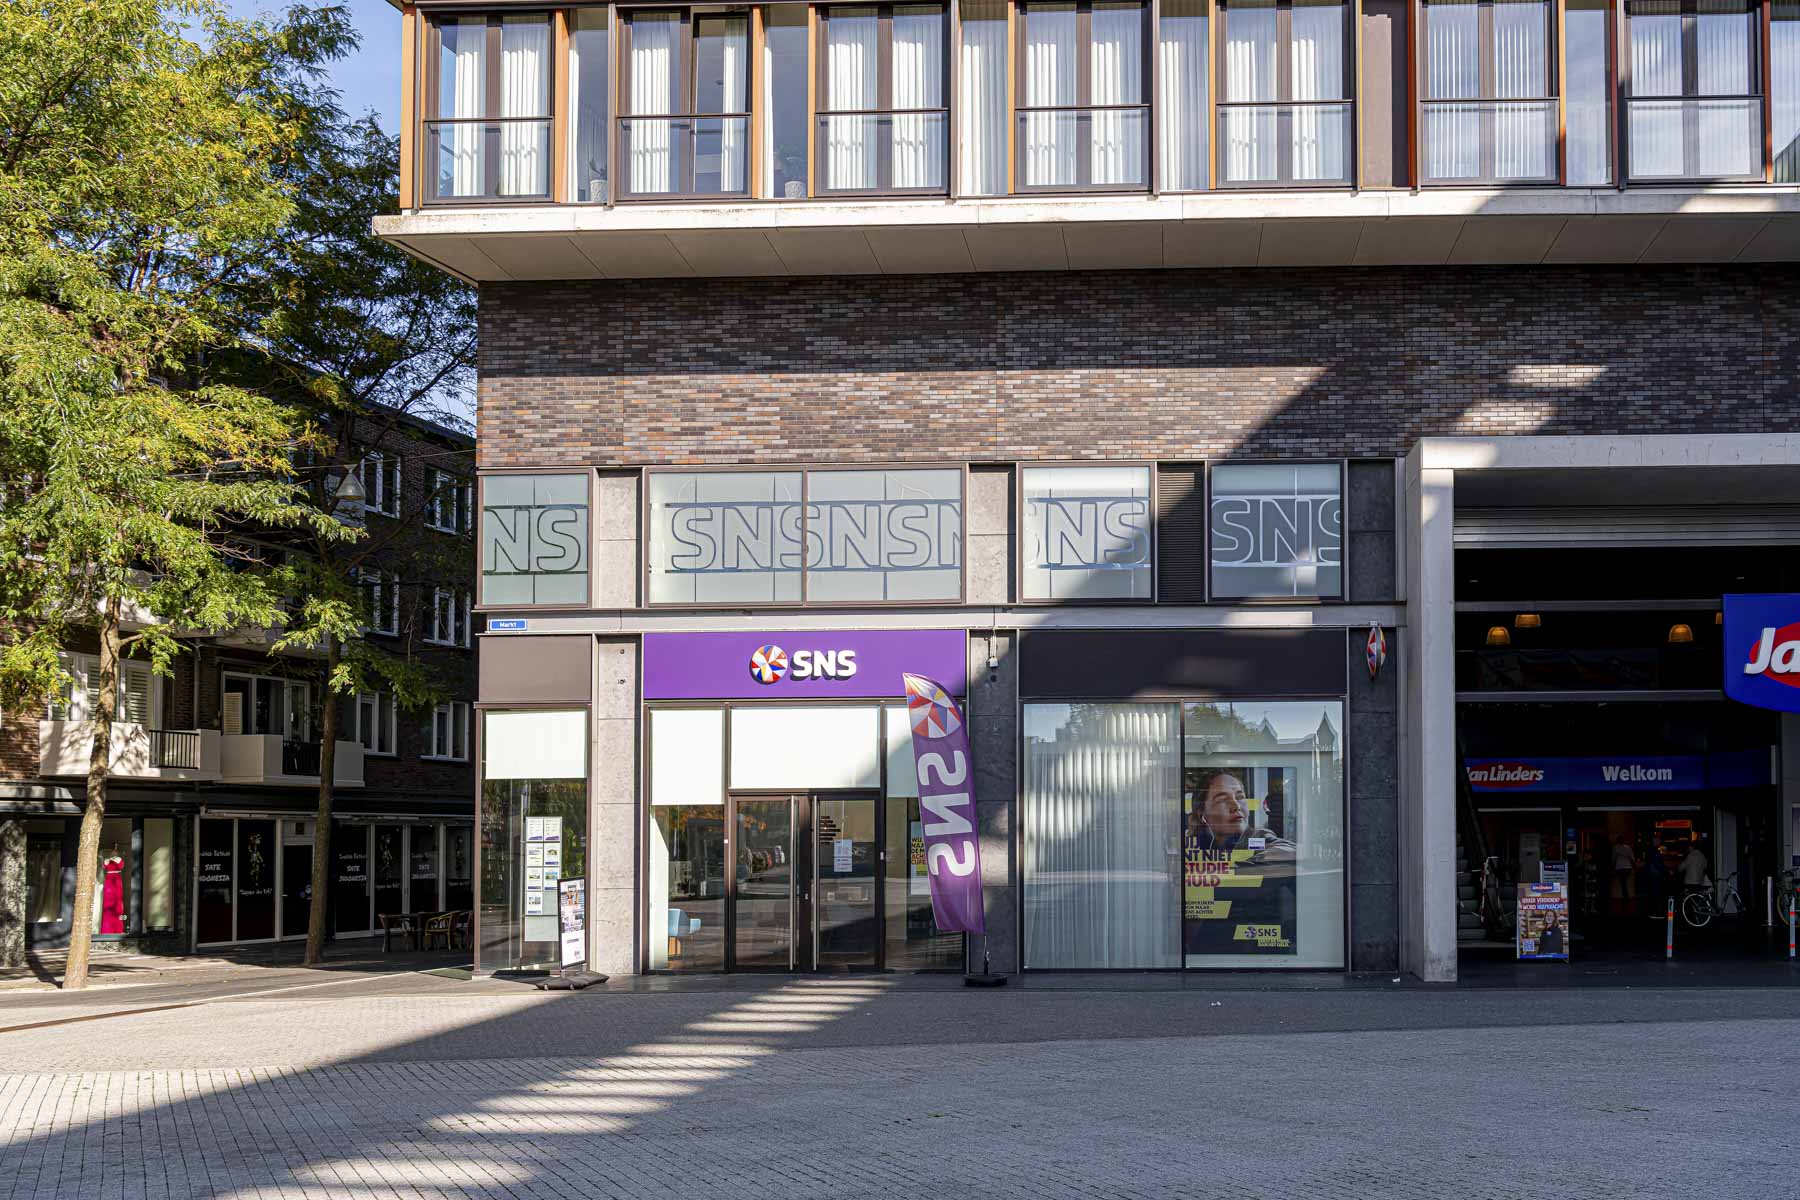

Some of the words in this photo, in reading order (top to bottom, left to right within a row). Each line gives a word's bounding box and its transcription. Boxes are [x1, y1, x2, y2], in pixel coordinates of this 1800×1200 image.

[1744, 626, 1800, 675] Ja
[792, 649, 857, 678] SNS
[1489, 764, 1544, 782] Linders
[1602, 764, 1673, 783] Welkom
[1203, 849, 1232, 862] NIET
[1258, 928, 1278, 937] SNS
